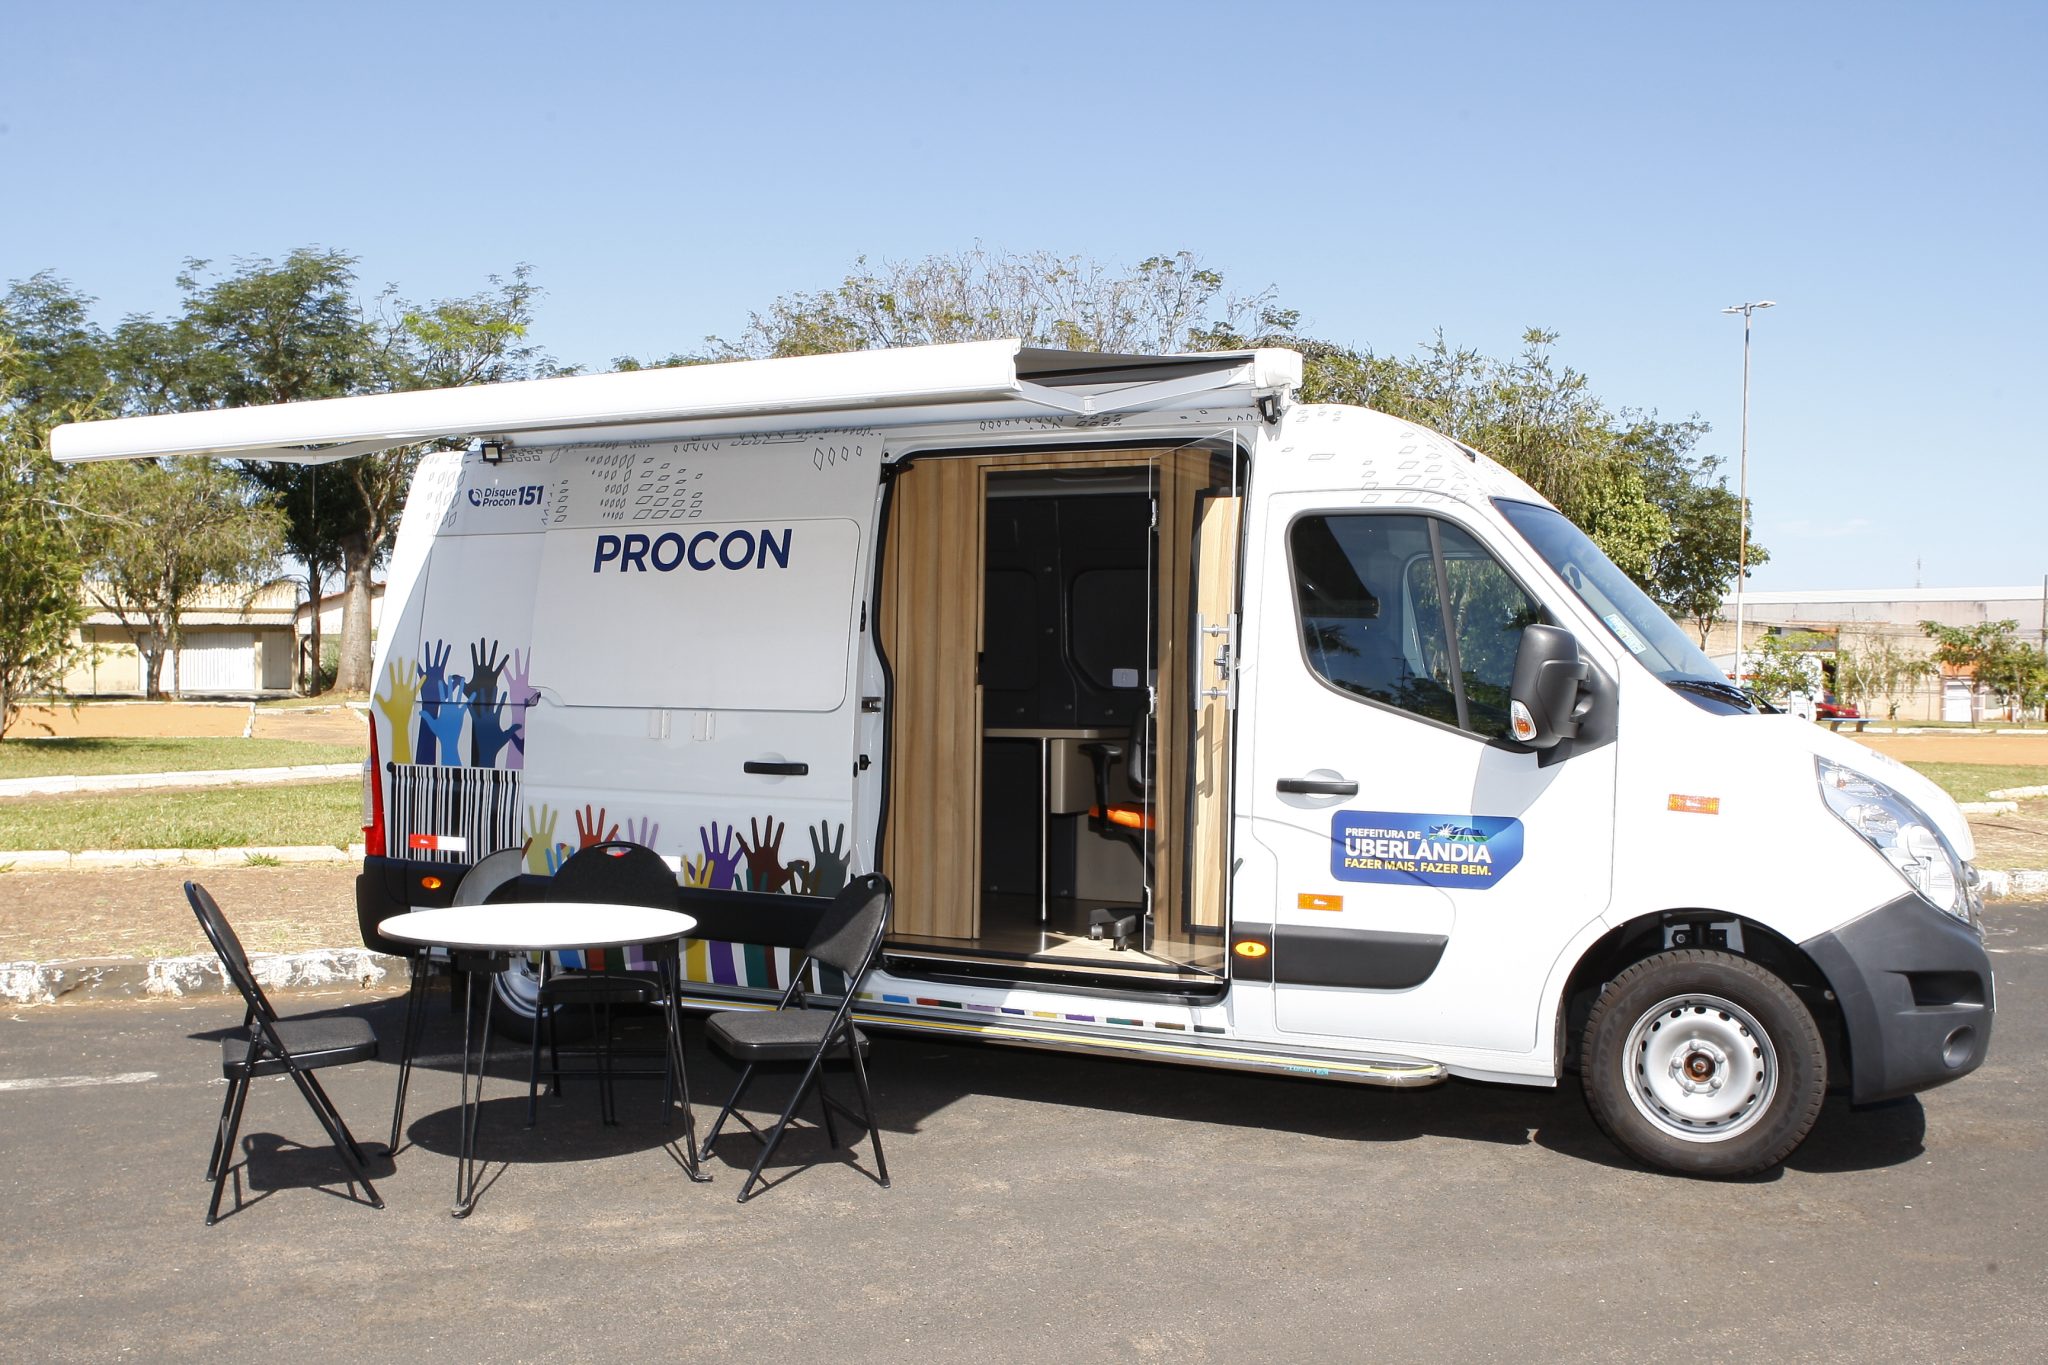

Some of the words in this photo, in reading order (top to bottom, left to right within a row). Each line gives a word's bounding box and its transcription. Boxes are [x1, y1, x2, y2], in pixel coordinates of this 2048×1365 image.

[482, 498, 516, 507] Procon
[484, 488, 517, 498] Disque
[518, 485, 544, 506] 151
[593, 528, 792, 573] PROCON
[1345, 827, 1405, 840] PREFEITURA
[1407, 830, 1421, 840] DE
[1345, 838, 1492, 864] UBERLÂNDIA
[1344, 858, 1382, 870] FAZER
[1384, 860, 1418, 872] MAIS.
[1420, 862, 1459, 874] FAZER
[1461, 864, 1492, 876] BEM.
